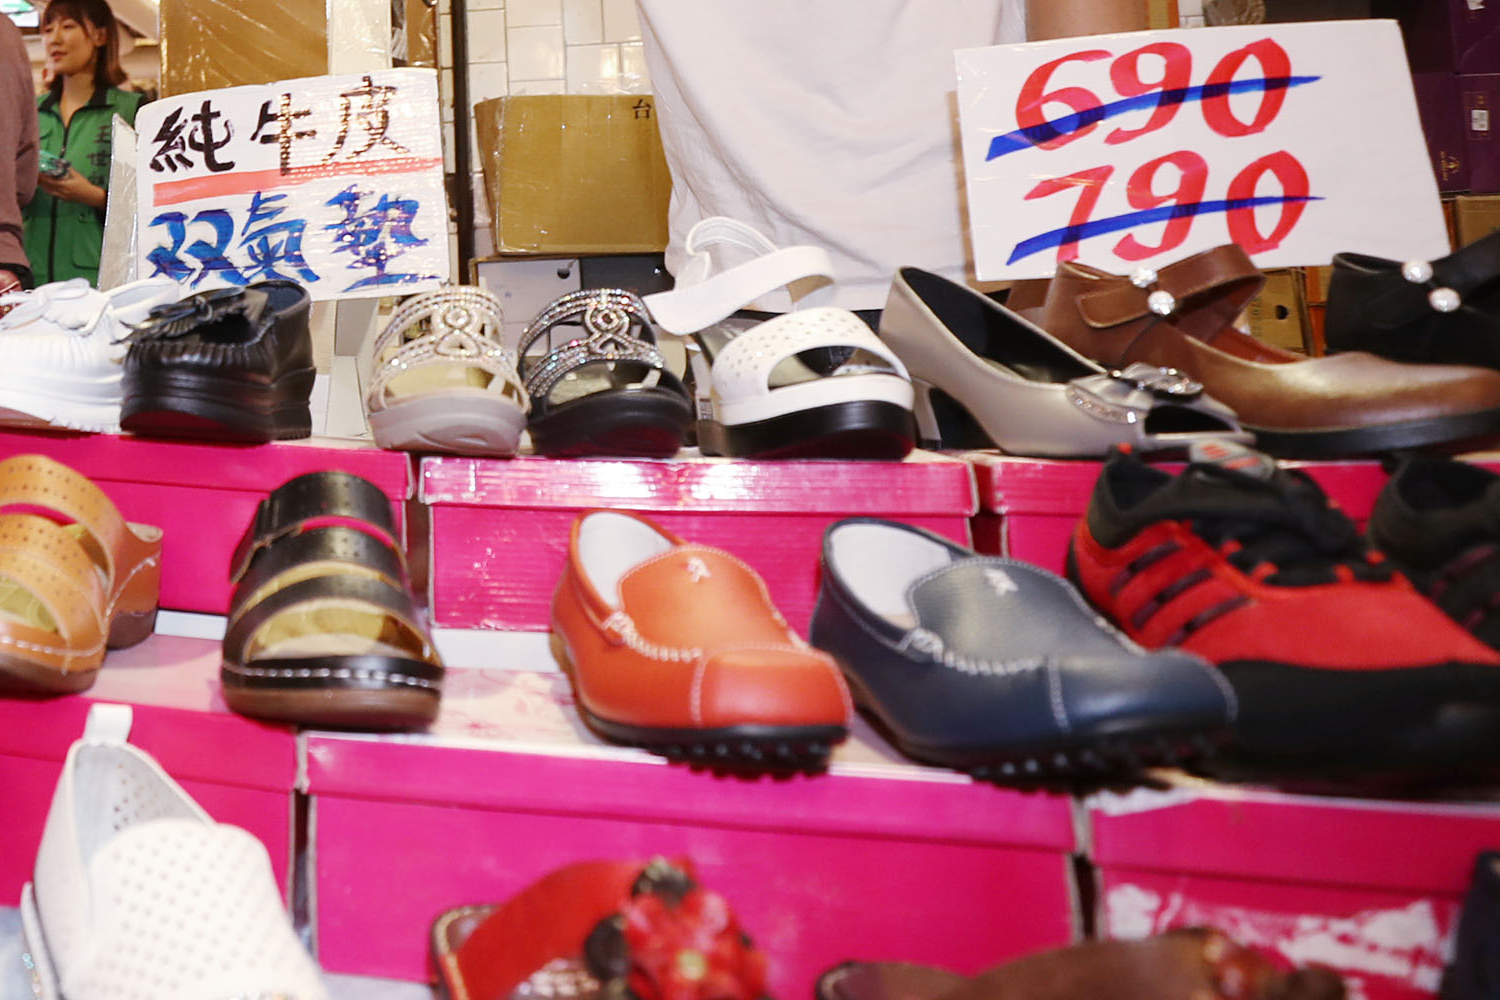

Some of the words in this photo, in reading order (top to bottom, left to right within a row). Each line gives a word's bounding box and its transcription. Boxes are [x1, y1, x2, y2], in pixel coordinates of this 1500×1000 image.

[150, 76, 410, 176] 純牛皮
[1016, 37, 1291, 151] 690
[1024, 150, 1310, 262] 790
